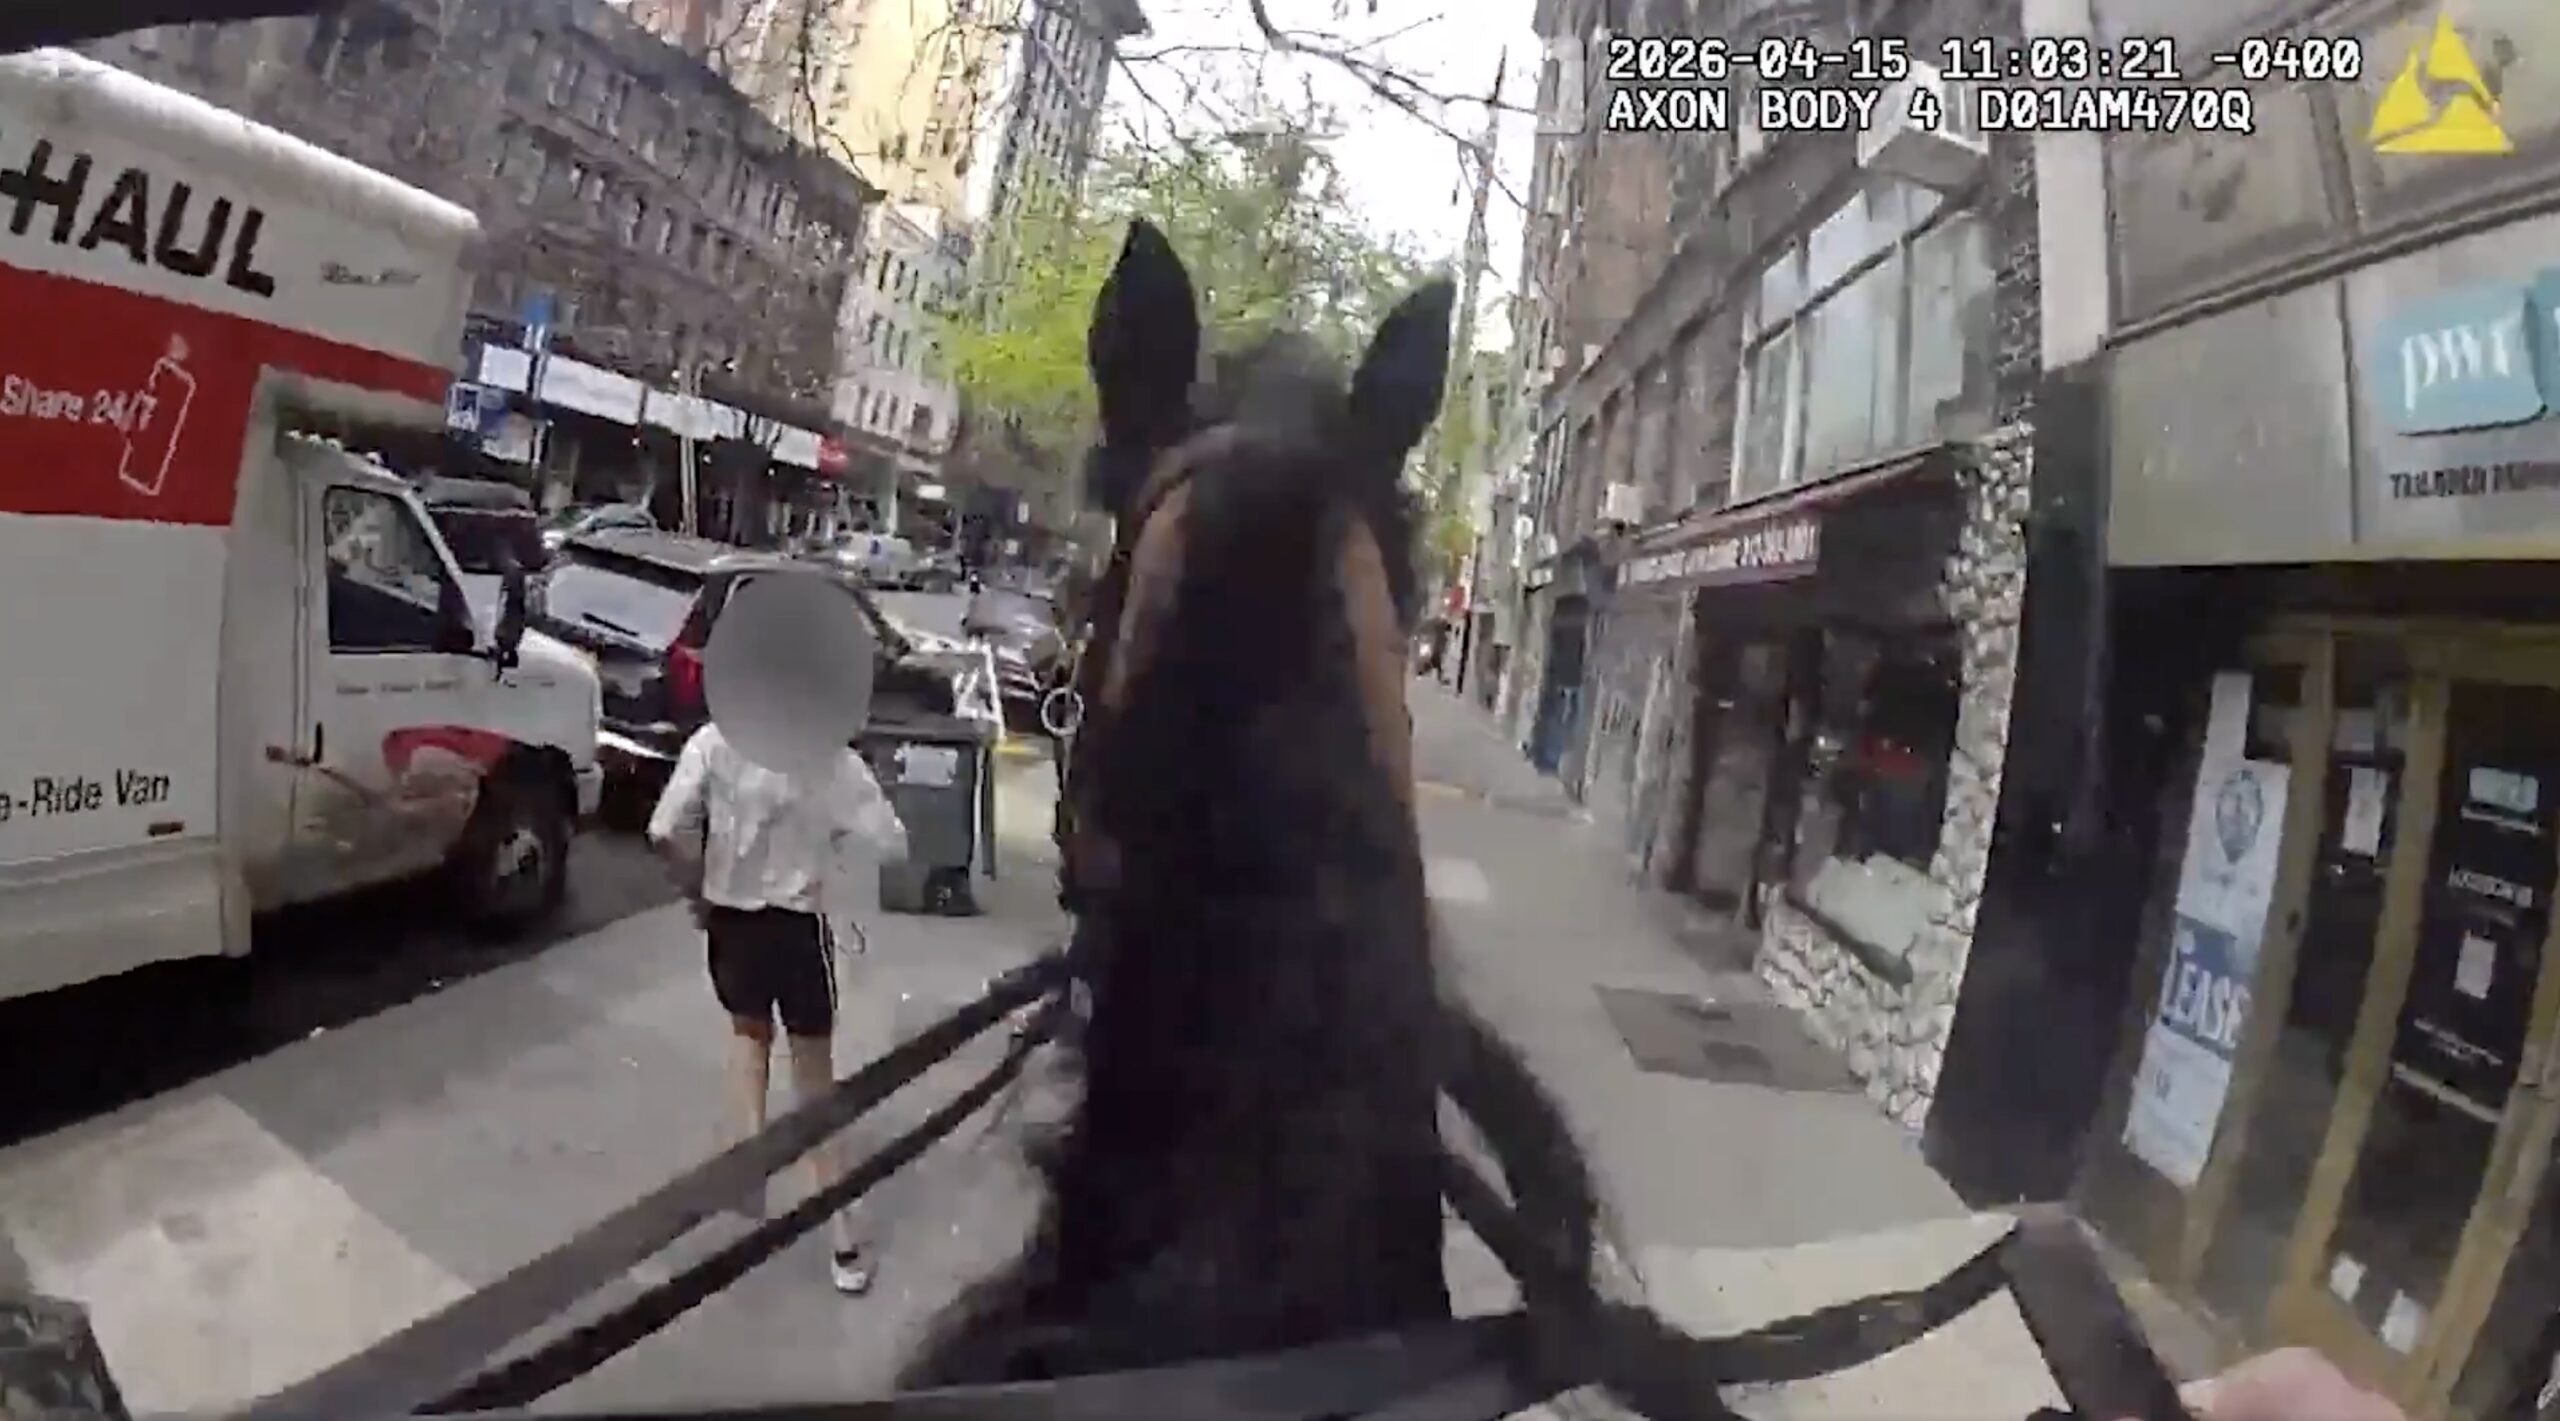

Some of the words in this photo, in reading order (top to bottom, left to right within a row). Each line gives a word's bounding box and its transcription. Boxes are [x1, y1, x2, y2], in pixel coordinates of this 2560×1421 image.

[0, 374, 83, 422] Share
[91, 388, 158, 432] 24/7
[116, 768, 169, 806] Van
[2159, 945, 2251, 1049] LEASE
